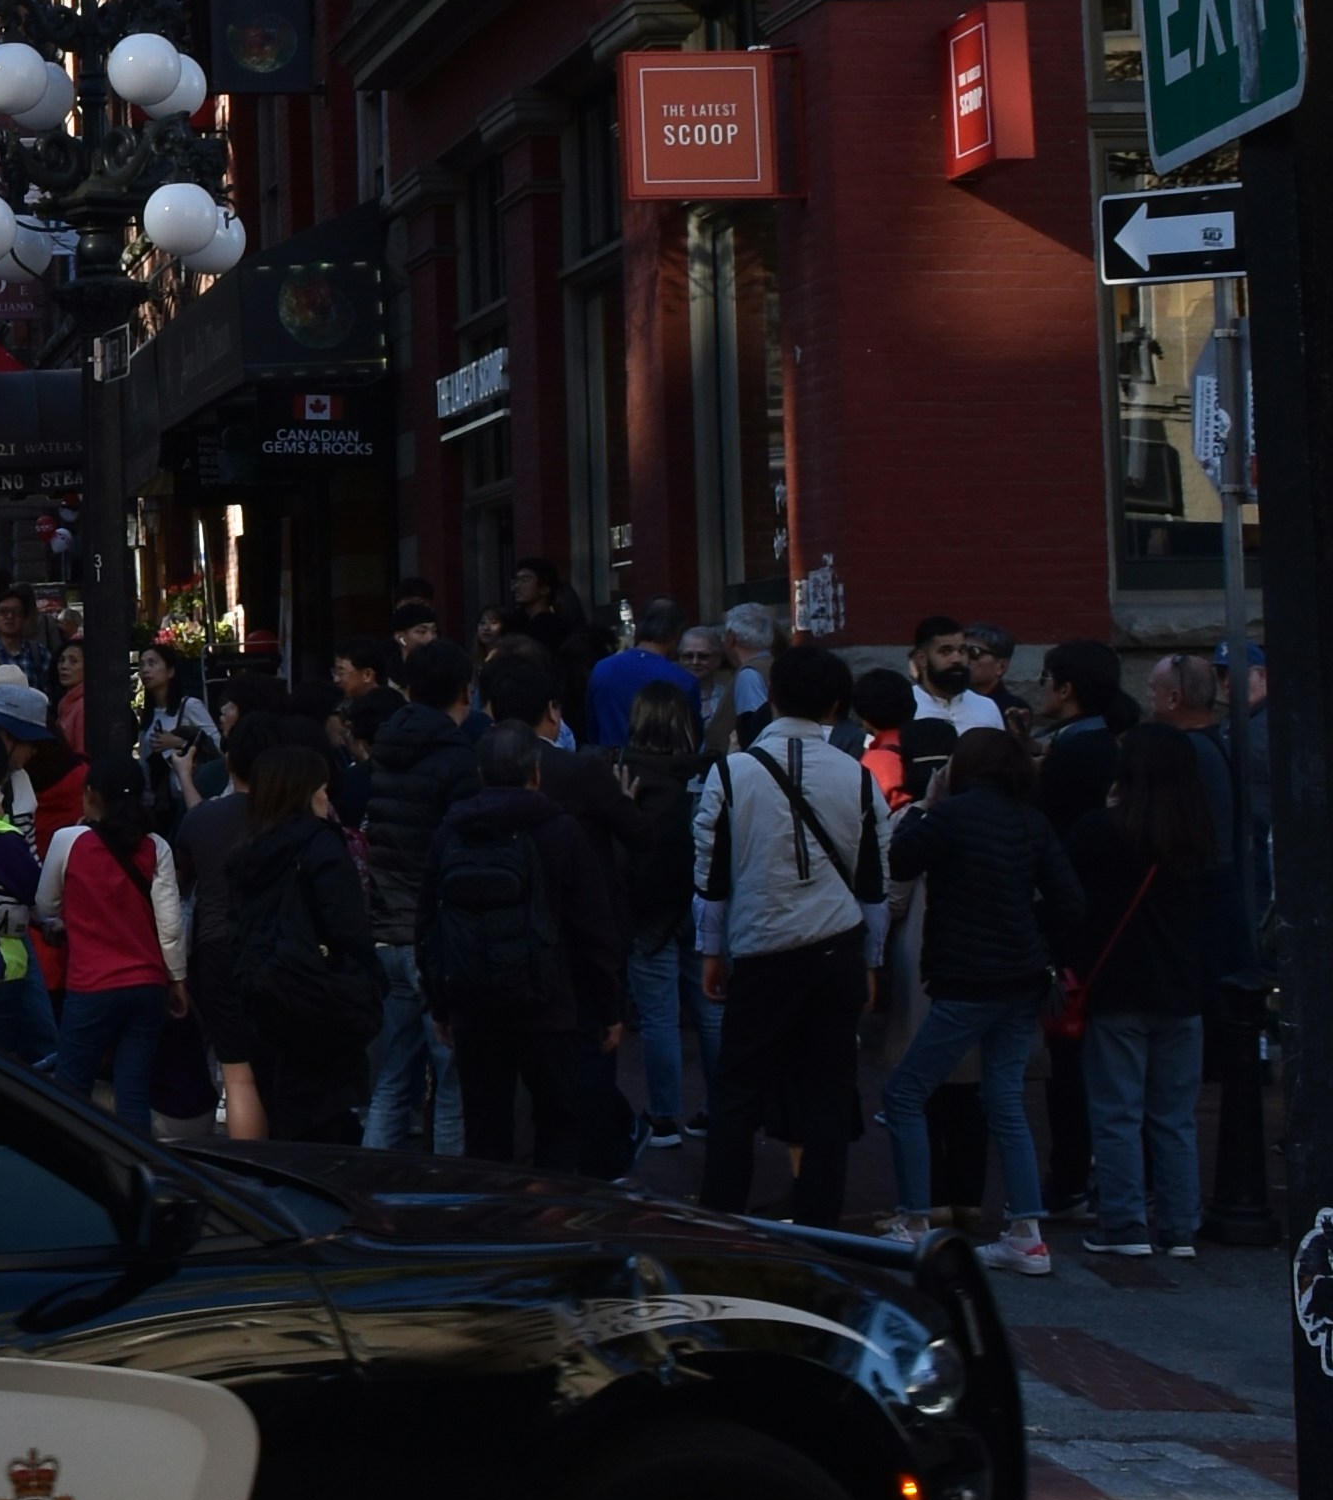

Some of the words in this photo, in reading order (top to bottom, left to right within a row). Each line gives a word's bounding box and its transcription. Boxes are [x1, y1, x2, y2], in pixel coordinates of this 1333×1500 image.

[959, 85, 983, 118] SCOOP
[661, 104, 686, 118] THE
[691, 103, 738, 118] LATEST
[663, 123, 739, 146] SCOOP
[276, 428, 359, 444] CANADIAN
[24, 442, 73, 454] WATER
[262, 440, 306, 455] GEMS
[308, 441, 321, 455] &
[322, 441, 373, 456] ROCKS
